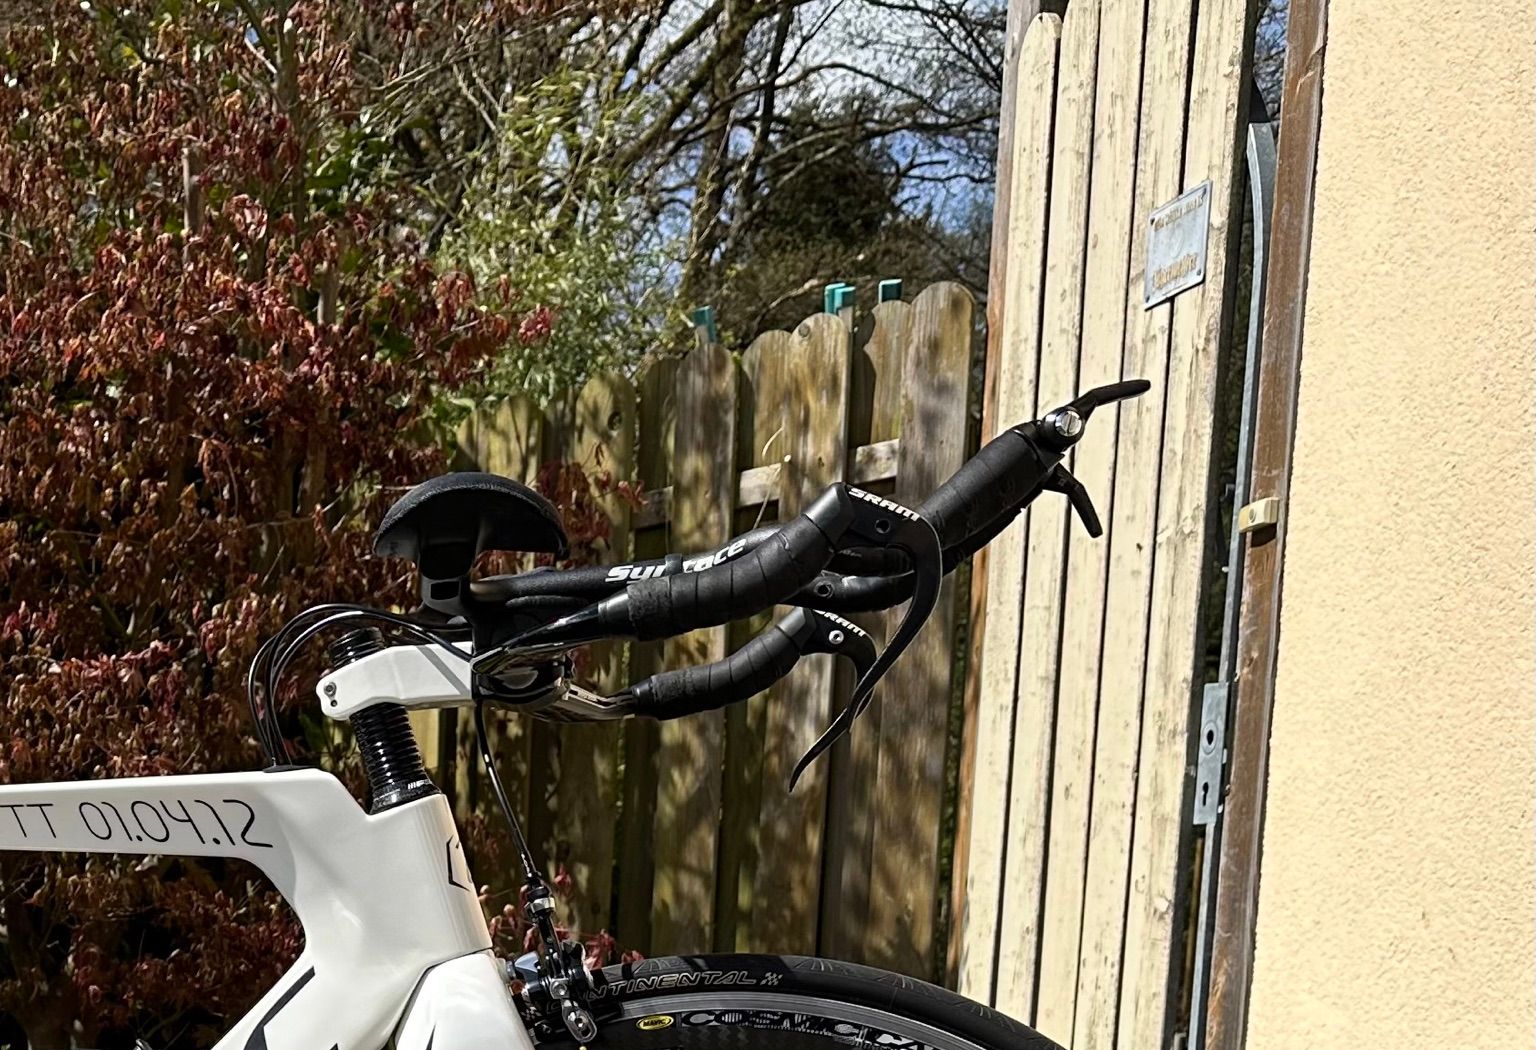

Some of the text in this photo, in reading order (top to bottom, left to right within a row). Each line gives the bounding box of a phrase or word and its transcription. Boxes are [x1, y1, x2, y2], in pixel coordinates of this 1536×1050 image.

[847, 486, 921, 522] SRAM
[0, 803, 57, 838] TT
[78, 799, 273, 848] 01.04.12
[544, 967, 757, 1020] CNTINENTAL
